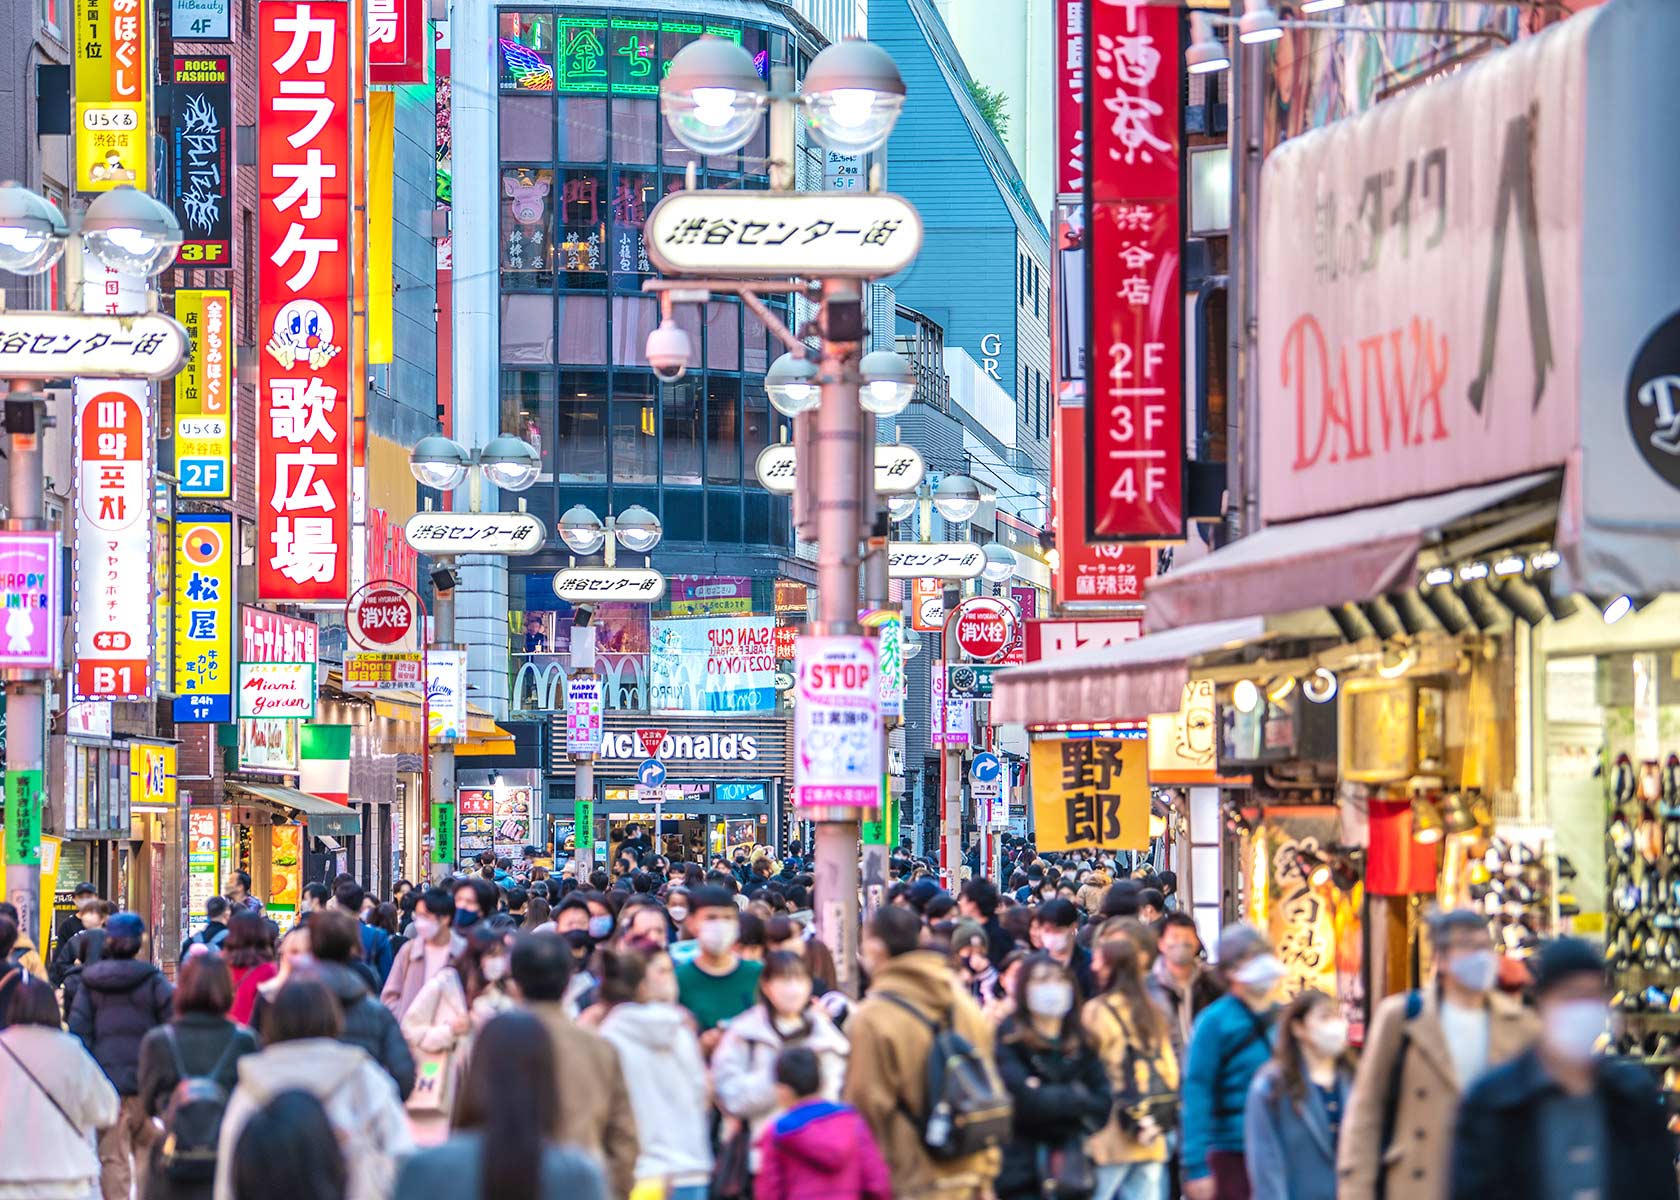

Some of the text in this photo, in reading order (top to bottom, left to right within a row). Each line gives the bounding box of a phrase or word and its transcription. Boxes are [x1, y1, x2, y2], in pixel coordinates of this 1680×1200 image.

[190, 19, 211, 33] 4F
[184, 60, 217, 71] ROCK
[566, 30, 674, 77] 金ち
[176, 71, 225, 82] FASHION
[89, 113, 133, 126] りらくる
[94, 134, 129, 147] 渋谷店
[270, 4, 338, 292] カラオケ
[665, 216, 903, 247] 渋谷センター街
[181, 244, 223, 261] 3F
[1117, 205, 1155, 305] 渋谷店
[206, 300, 223, 411] 全身もみほぐし
[1108, 342, 1165, 379] 2F
[1280, 313, 1449, 472] DAIWA
[182, 423, 222, 434] りらくる
[1109, 404, 1166, 442] 3F
[97, 401, 127, 520] 마약포차
[182, 442, 222, 455] 渋谷店
[186, 464, 219, 487] 2F
[269, 376, 338, 585] 歌広場
[1109, 467, 1167, 504] 4F
[412, 524, 533, 541] 渋谷センター街
[889, 552, 976, 567] 谷センター街
[560, 578, 657, 592] 渋谷センター街
[186, 572, 219, 639] 松屋
[361, 605, 408, 628] 消火栓
[961, 622, 1004, 643] 消火栓
[186, 661, 196, 690] 定食
[198, 655, 207, 685] カレー
[208, 649, 218, 681] 牛めし
[811, 664, 870, 688] STOP
[93, 666, 131, 694] B1
[243, 677, 297, 691] Miami
[191, 696, 213, 705] 24h
[193, 708, 209, 719] 1F
[1060, 740, 1123, 845] 野郎
